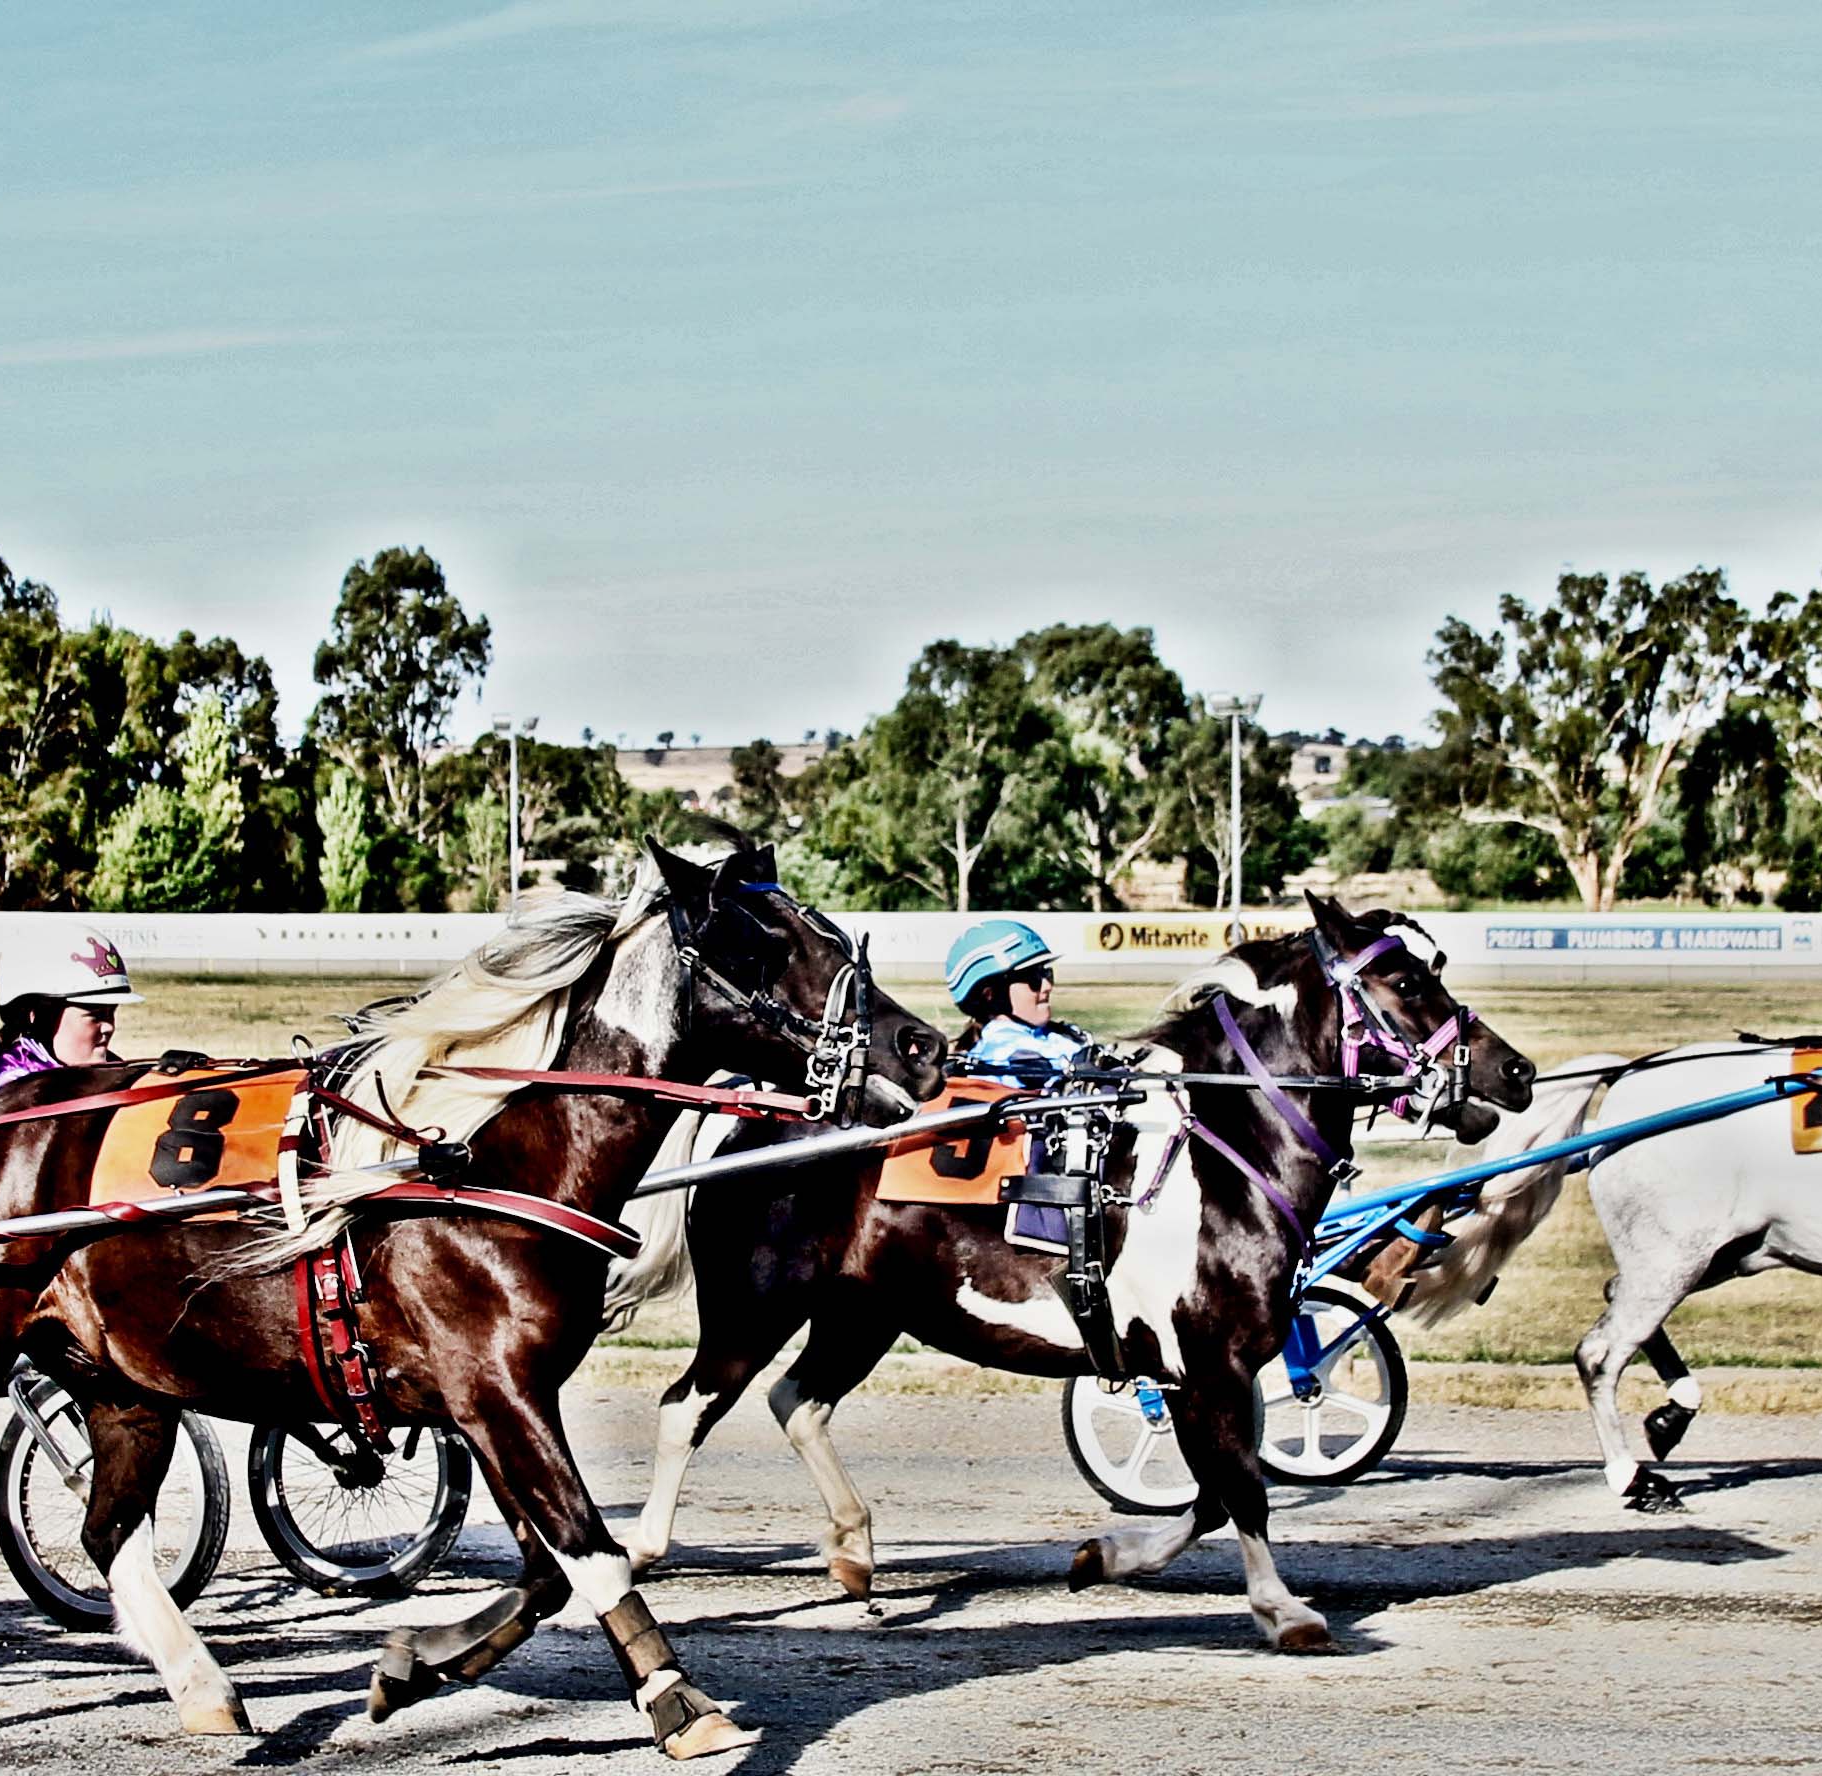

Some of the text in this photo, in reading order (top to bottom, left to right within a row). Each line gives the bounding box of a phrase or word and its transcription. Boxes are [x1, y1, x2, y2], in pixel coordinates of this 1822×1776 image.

[1129, 926, 1209, 948] Mitavite
[1568, 929, 1655, 949] PLUMBING
[1678, 929, 1780, 950] HARDWARE
[148, 1088, 241, 1189] 8
